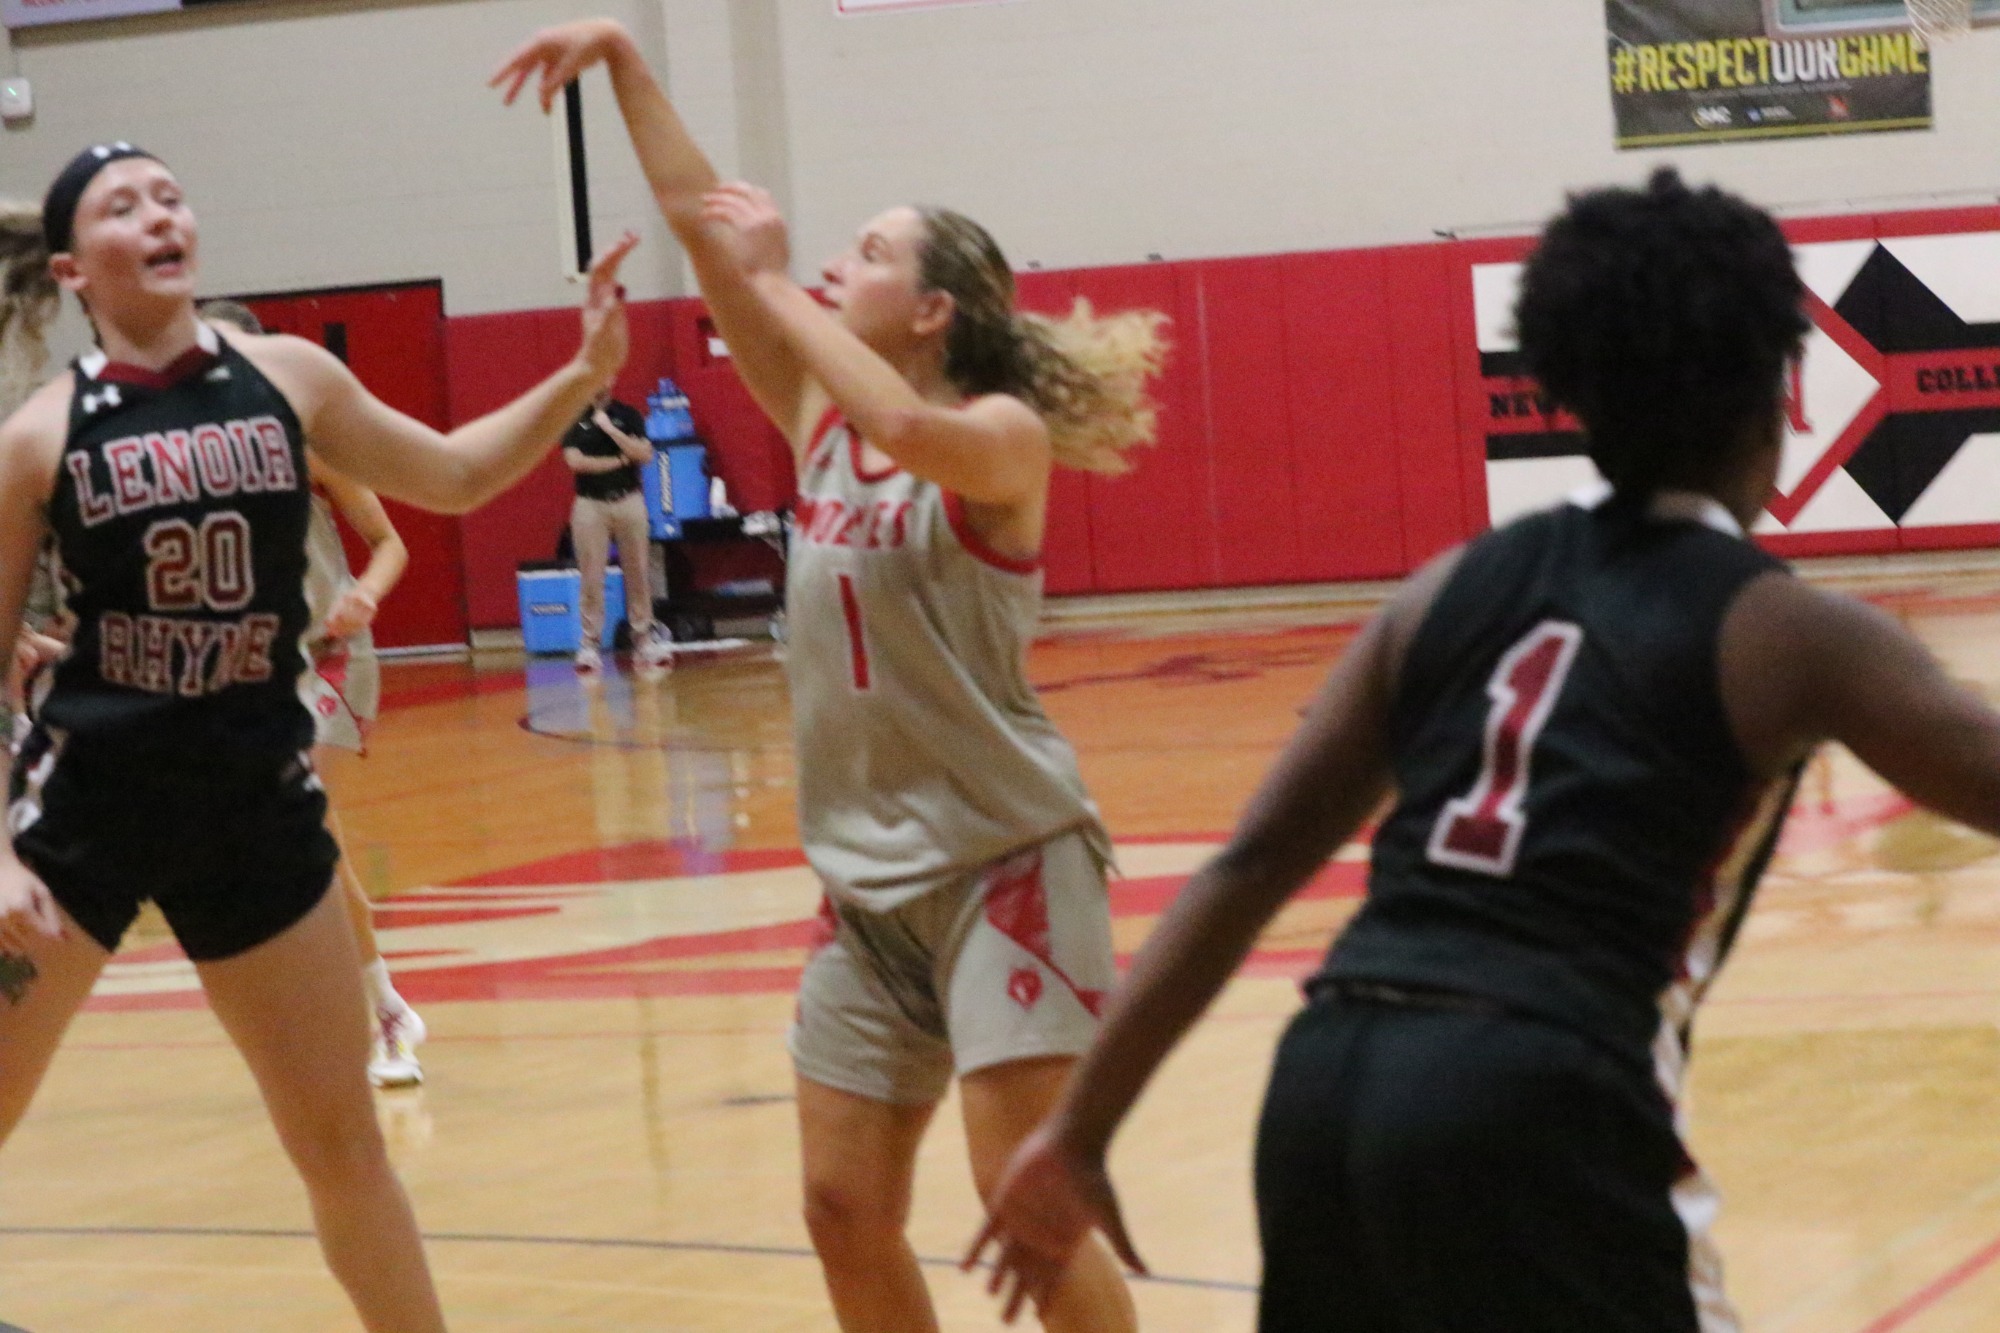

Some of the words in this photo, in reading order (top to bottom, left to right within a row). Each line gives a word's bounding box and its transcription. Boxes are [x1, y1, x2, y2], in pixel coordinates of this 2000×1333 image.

[1612, 32, 1928, 94] #RESPECTOURGAME
[66, 415, 297, 528] LENOIR
[143, 511, 254, 611] 20
[837, 572, 870, 690] 1
[1426, 618, 1583, 877] 1
